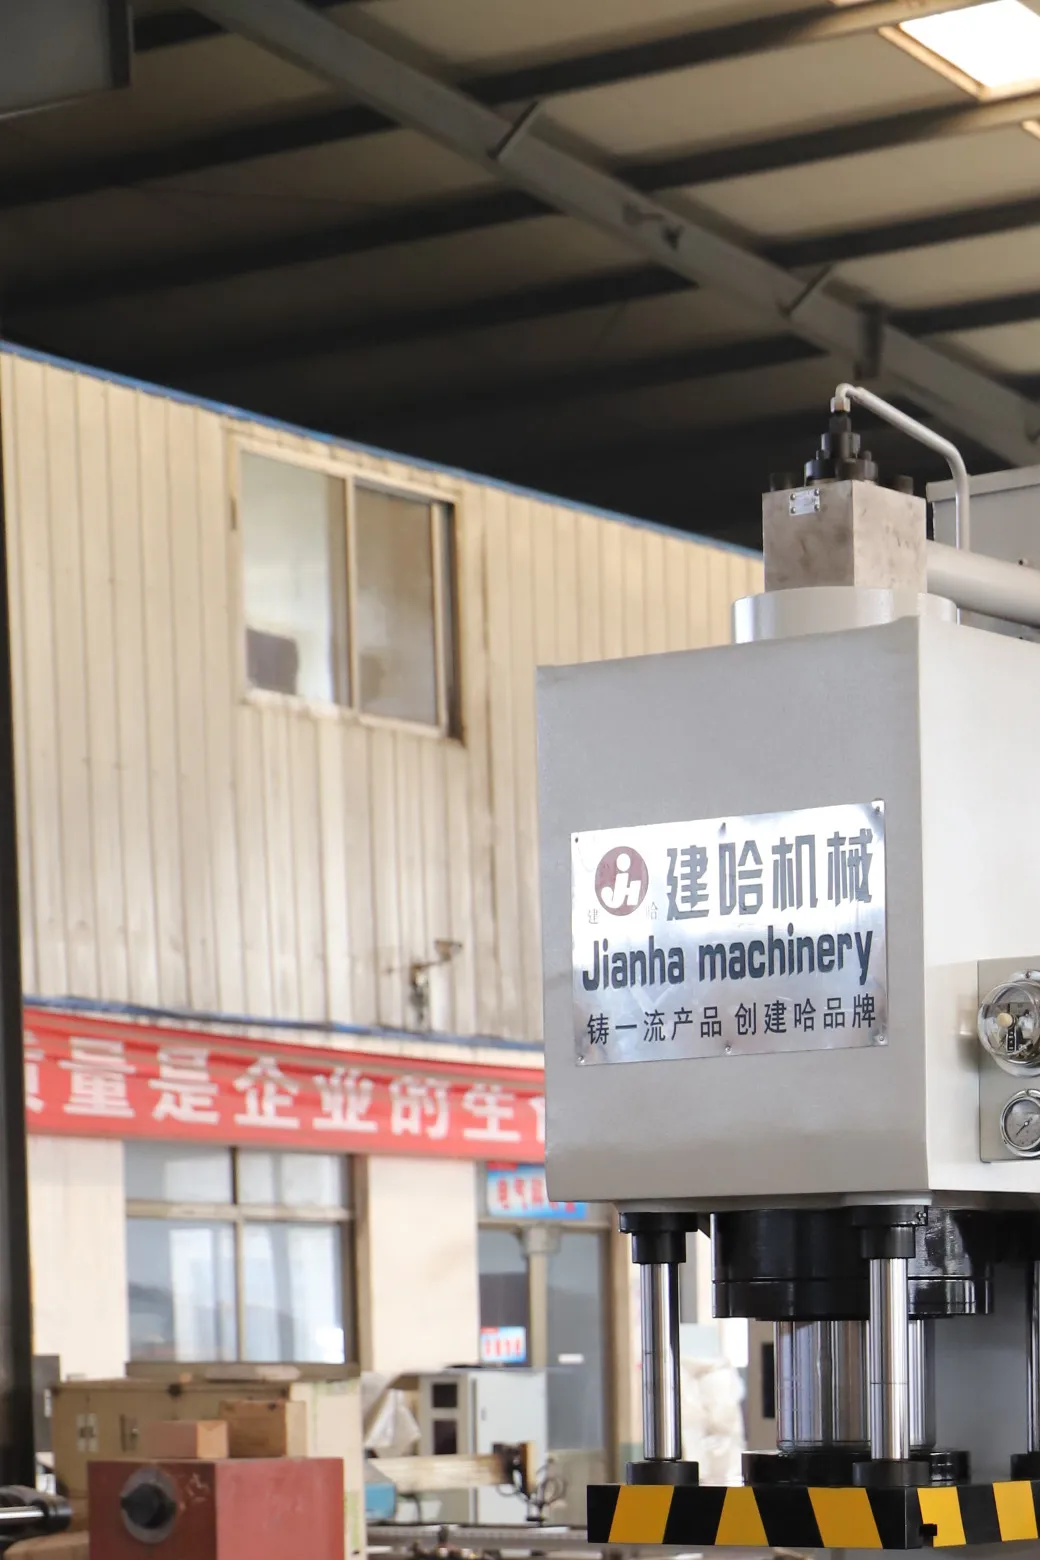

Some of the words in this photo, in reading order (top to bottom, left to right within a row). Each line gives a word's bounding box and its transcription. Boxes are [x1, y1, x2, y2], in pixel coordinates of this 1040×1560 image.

[666, 828, 874, 921] 建哈机械
[582, 935, 685, 992] Jianha
[698, 922, 874, 986] machinery
[587, 1005, 723, 1045] 铸一流产品
[734, 993, 877, 1037] 创建哈品牌
[24, 1028, 545, 1144] 量是企业的生
